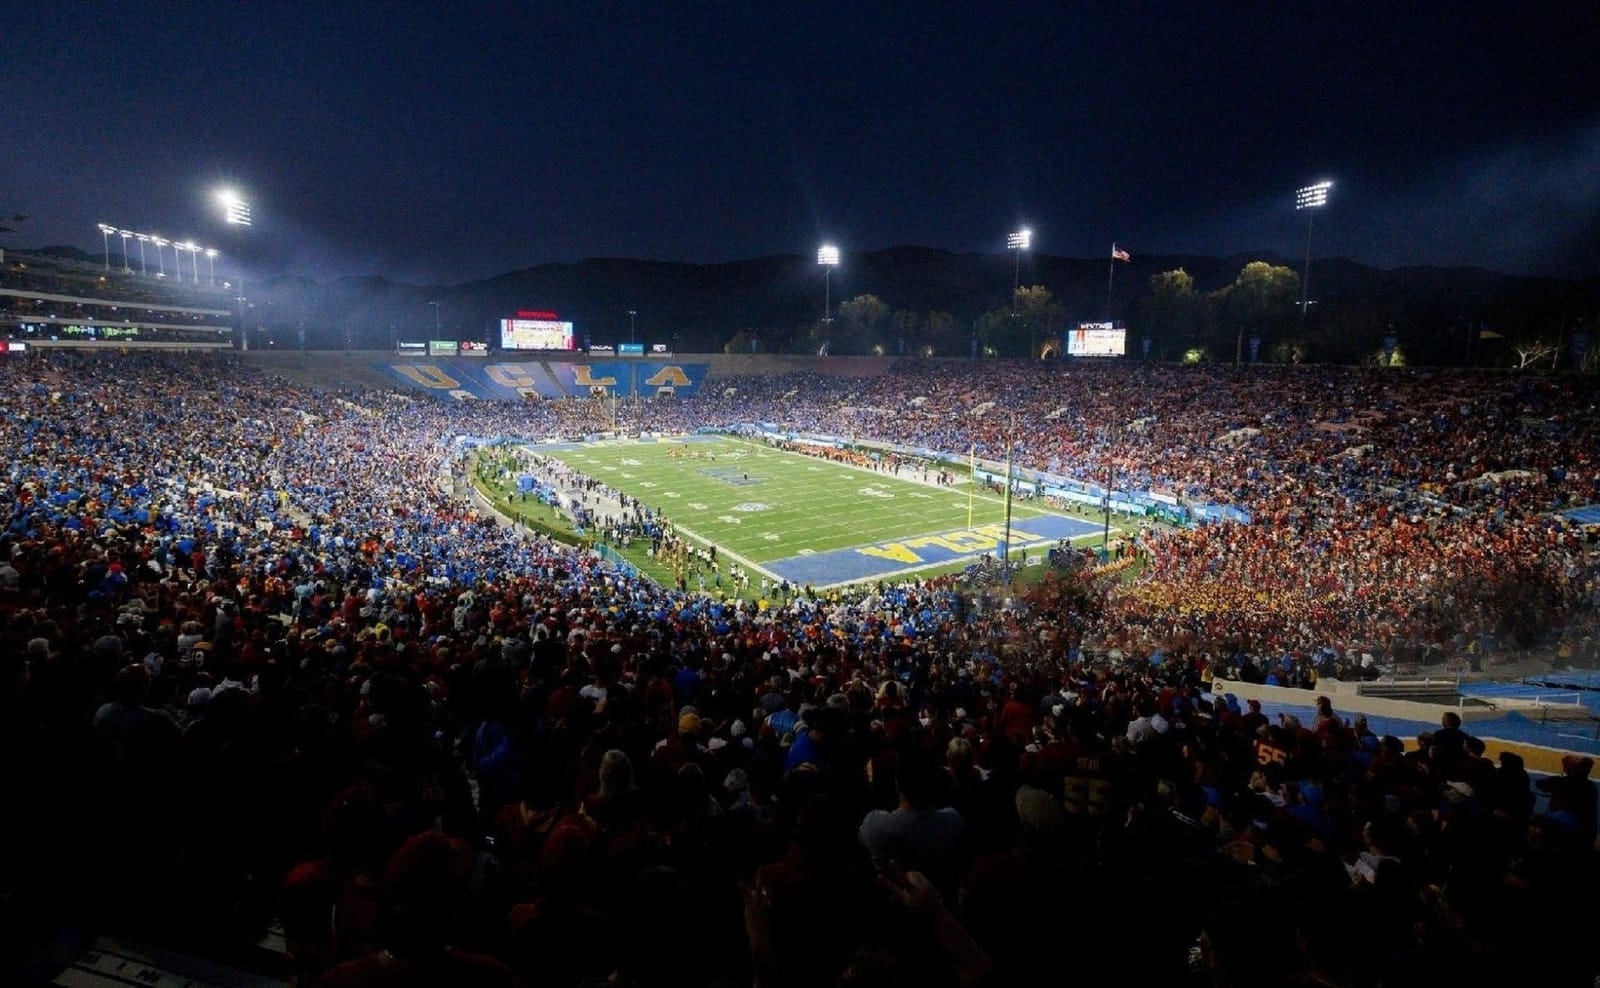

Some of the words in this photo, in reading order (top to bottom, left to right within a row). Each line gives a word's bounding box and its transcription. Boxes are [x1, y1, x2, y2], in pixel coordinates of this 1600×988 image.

[391, 364, 692, 390] UCLA
[854, 524, 1046, 564] UCLA
[1257, 743, 1288, 768] 55
[1062, 776, 1112, 817] 55
